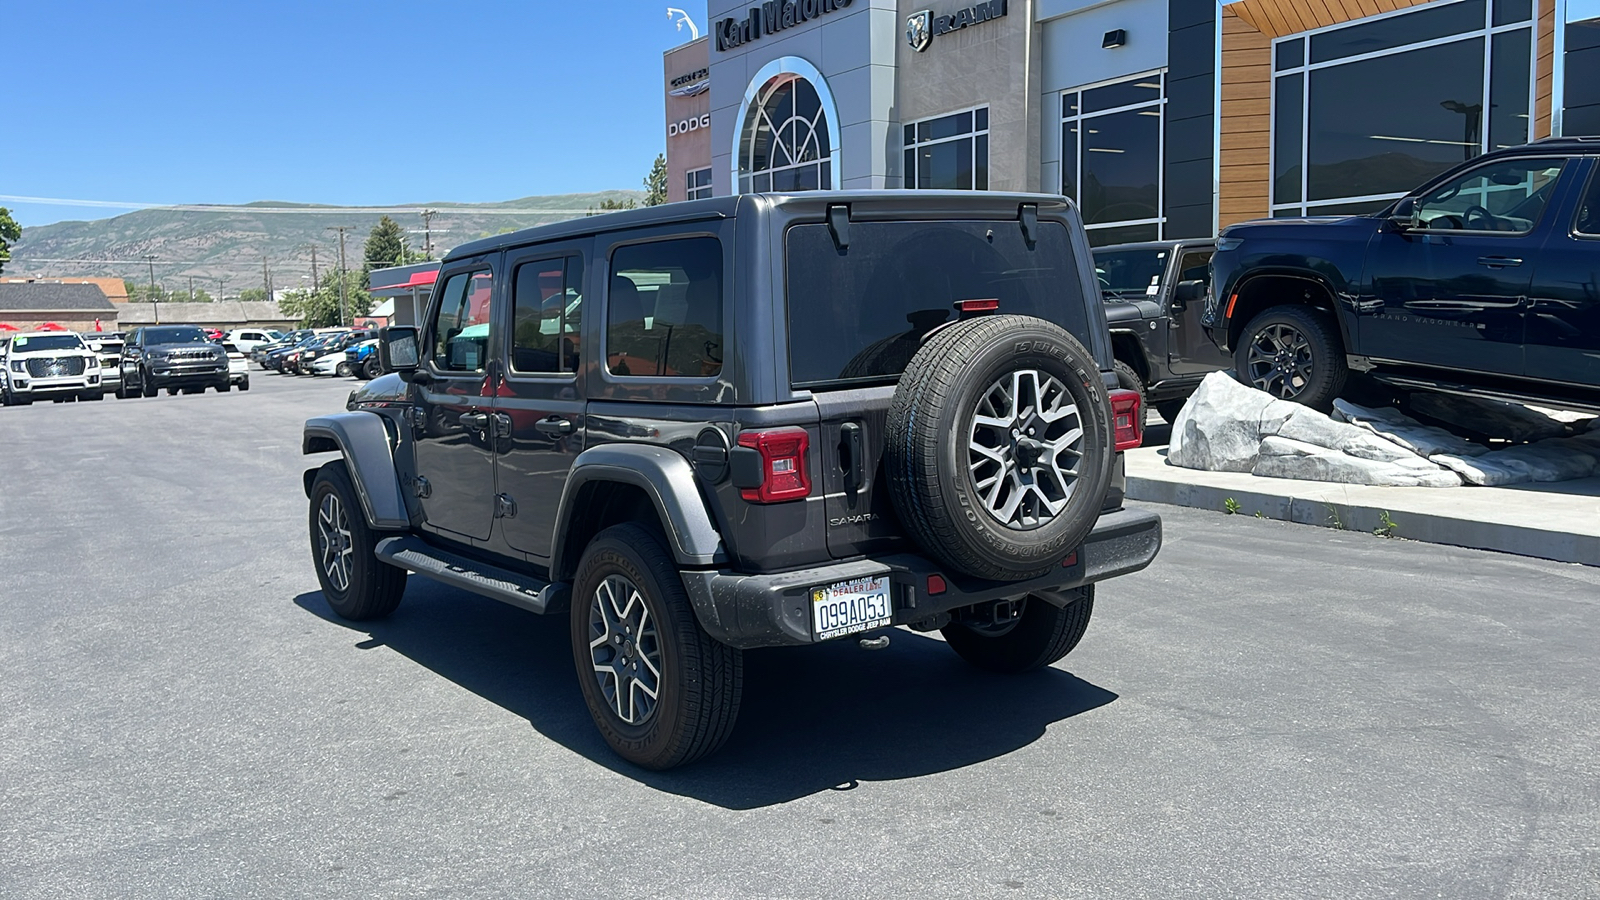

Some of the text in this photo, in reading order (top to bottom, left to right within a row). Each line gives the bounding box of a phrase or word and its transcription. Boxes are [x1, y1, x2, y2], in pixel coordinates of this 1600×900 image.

[715, 8, 760, 51] Karl
[933, 0, 1007, 36] RAM
[1372, 313, 1475, 328] GRAND WAGONEER
[1013, 340, 1100, 405] DUELER
[829, 513, 880, 526] SAHARA
[833, 584, 864, 597] DEALER
[820, 593, 886, 630] 099A053
[820, 617, 891, 640] CHRYSLER DODGE JEEP RAM
